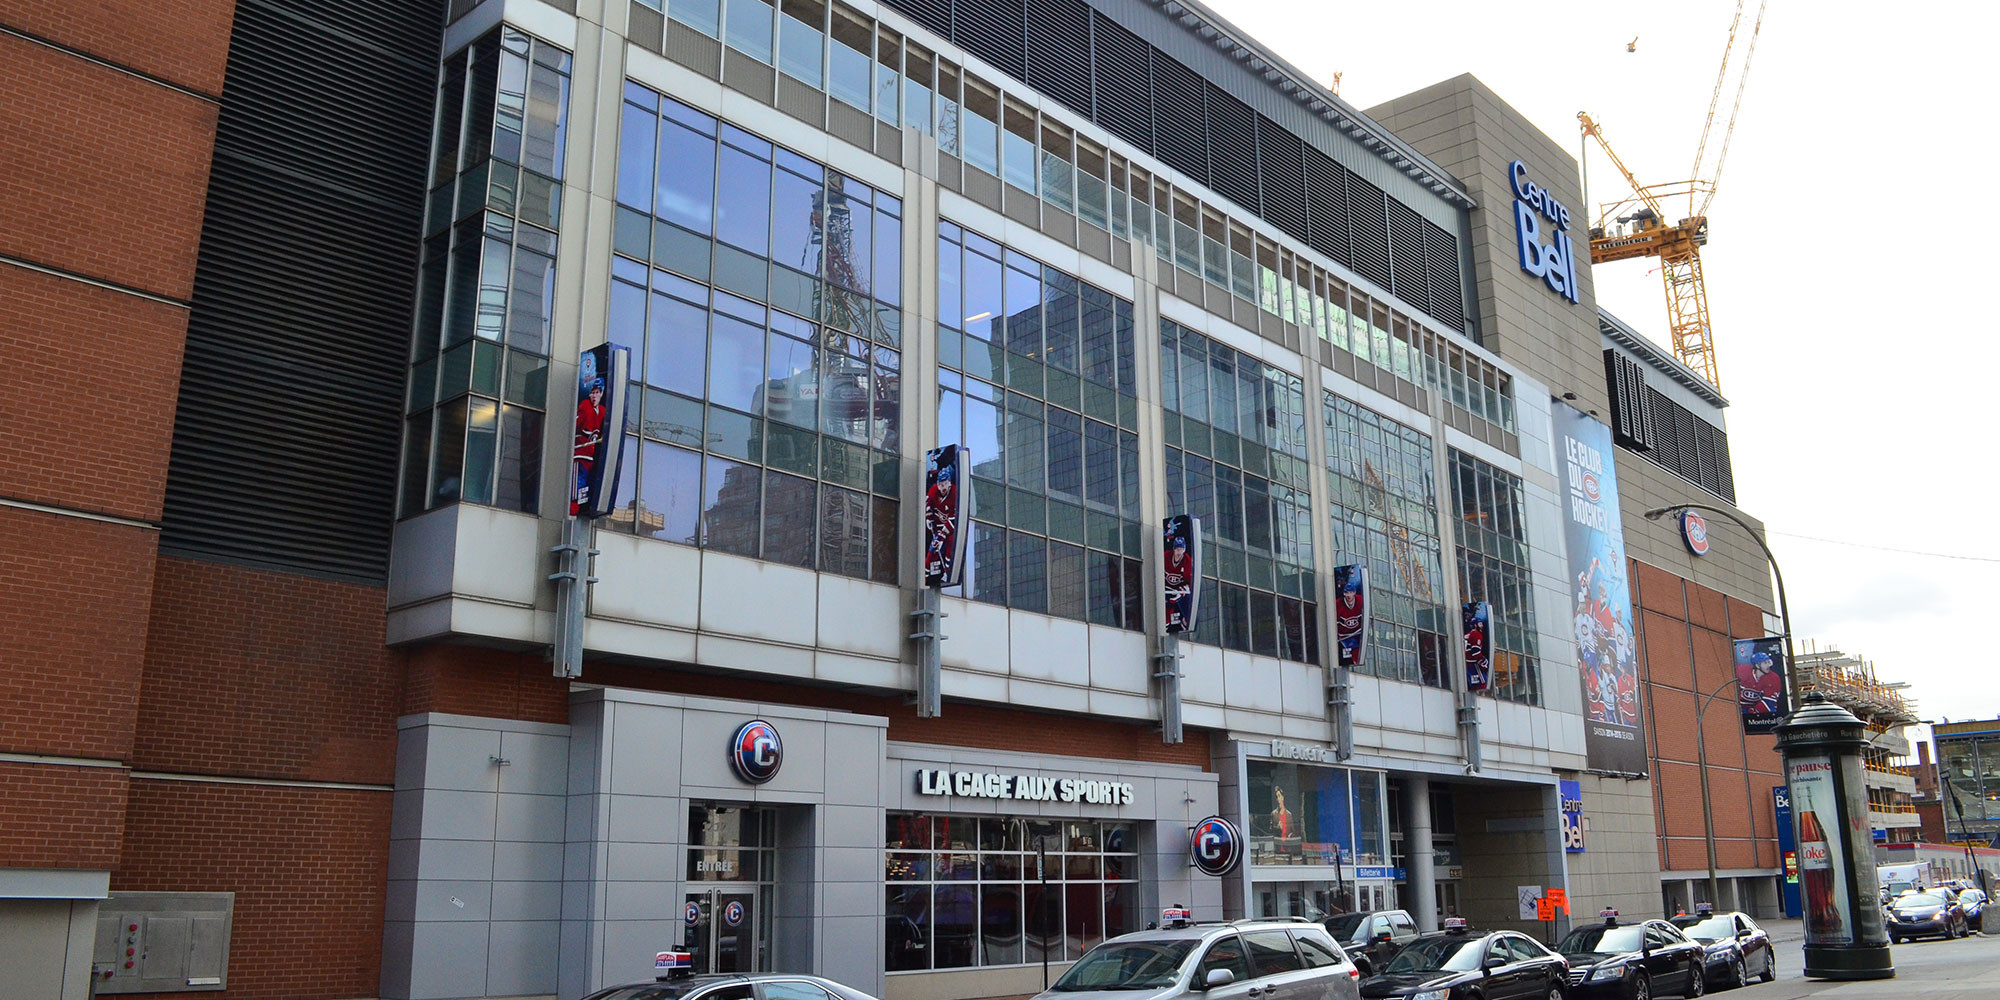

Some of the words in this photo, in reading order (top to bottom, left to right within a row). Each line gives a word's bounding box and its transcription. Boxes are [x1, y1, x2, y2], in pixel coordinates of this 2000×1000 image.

[1509, 160, 1570, 230] Centre
[1513, 199, 1579, 304] Bell
[1599, 236, 1651, 250] LIEBHERR
[1564, 434, 1577, 464] LE
[1577, 441, 1602, 475] CLUB
[1567, 461, 1582, 491] DU
[1571, 495, 1608, 534] HOCKEY
[921, 769, 952, 796] LA
[954, 771, 1012, 799] CAGE
[1014, 775, 1060, 801] AUX
[1059, 778, 1135, 805] SPORTS
[1796, 762, 1831, 776] pause
[1801, 846, 1826, 860] Coke
